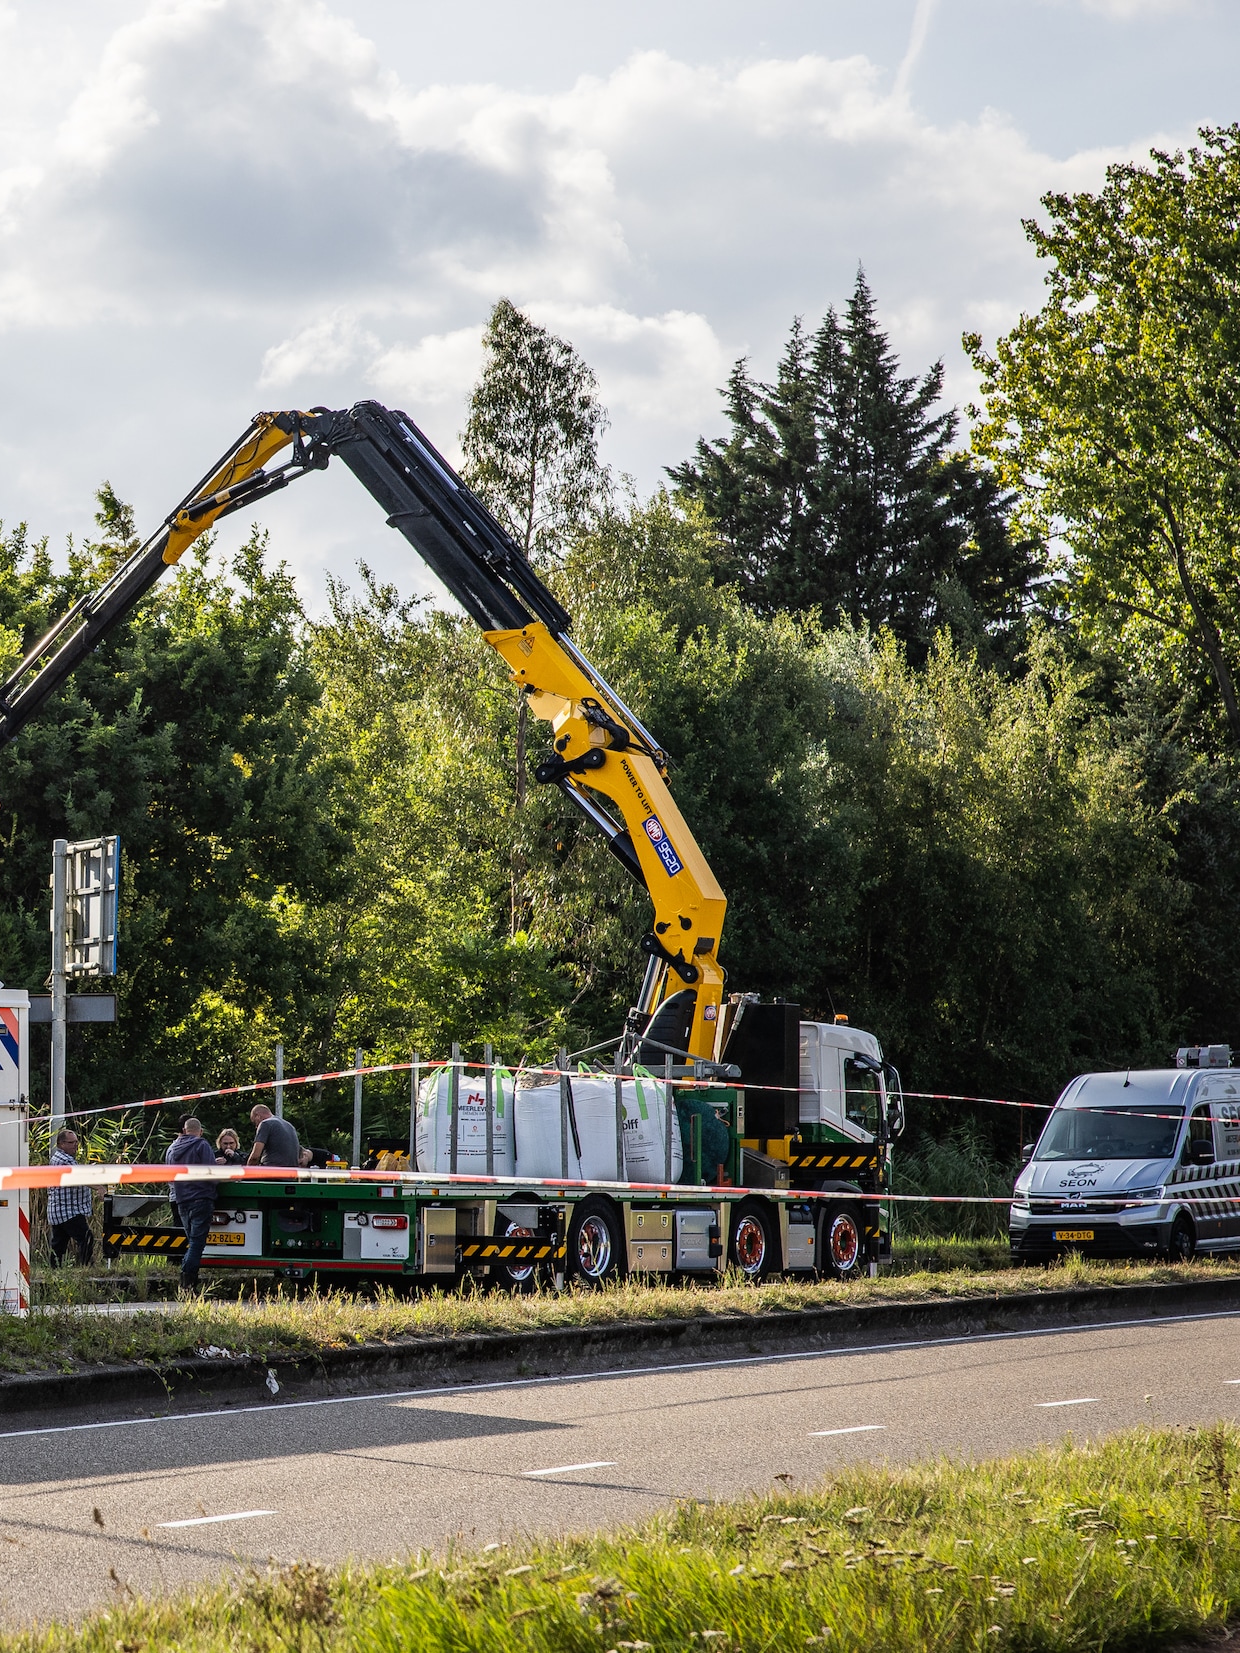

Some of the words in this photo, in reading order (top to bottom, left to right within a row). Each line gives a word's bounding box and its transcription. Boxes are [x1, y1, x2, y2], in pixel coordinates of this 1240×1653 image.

[620, 759, 637, 788] POWER
[635, 786, 644, 799] TO
[641, 798, 653, 815] LIFT
[647, 820, 662, 840] HMF
[658, 841, 681, 874] 9520
[622, 1119, 639, 1131] olff
[1221, 1105, 1240, 1129] SE
[1059, 1179, 1097, 1188] SEON
[1057, 1231, 1092, 1240] V-34-DTG
